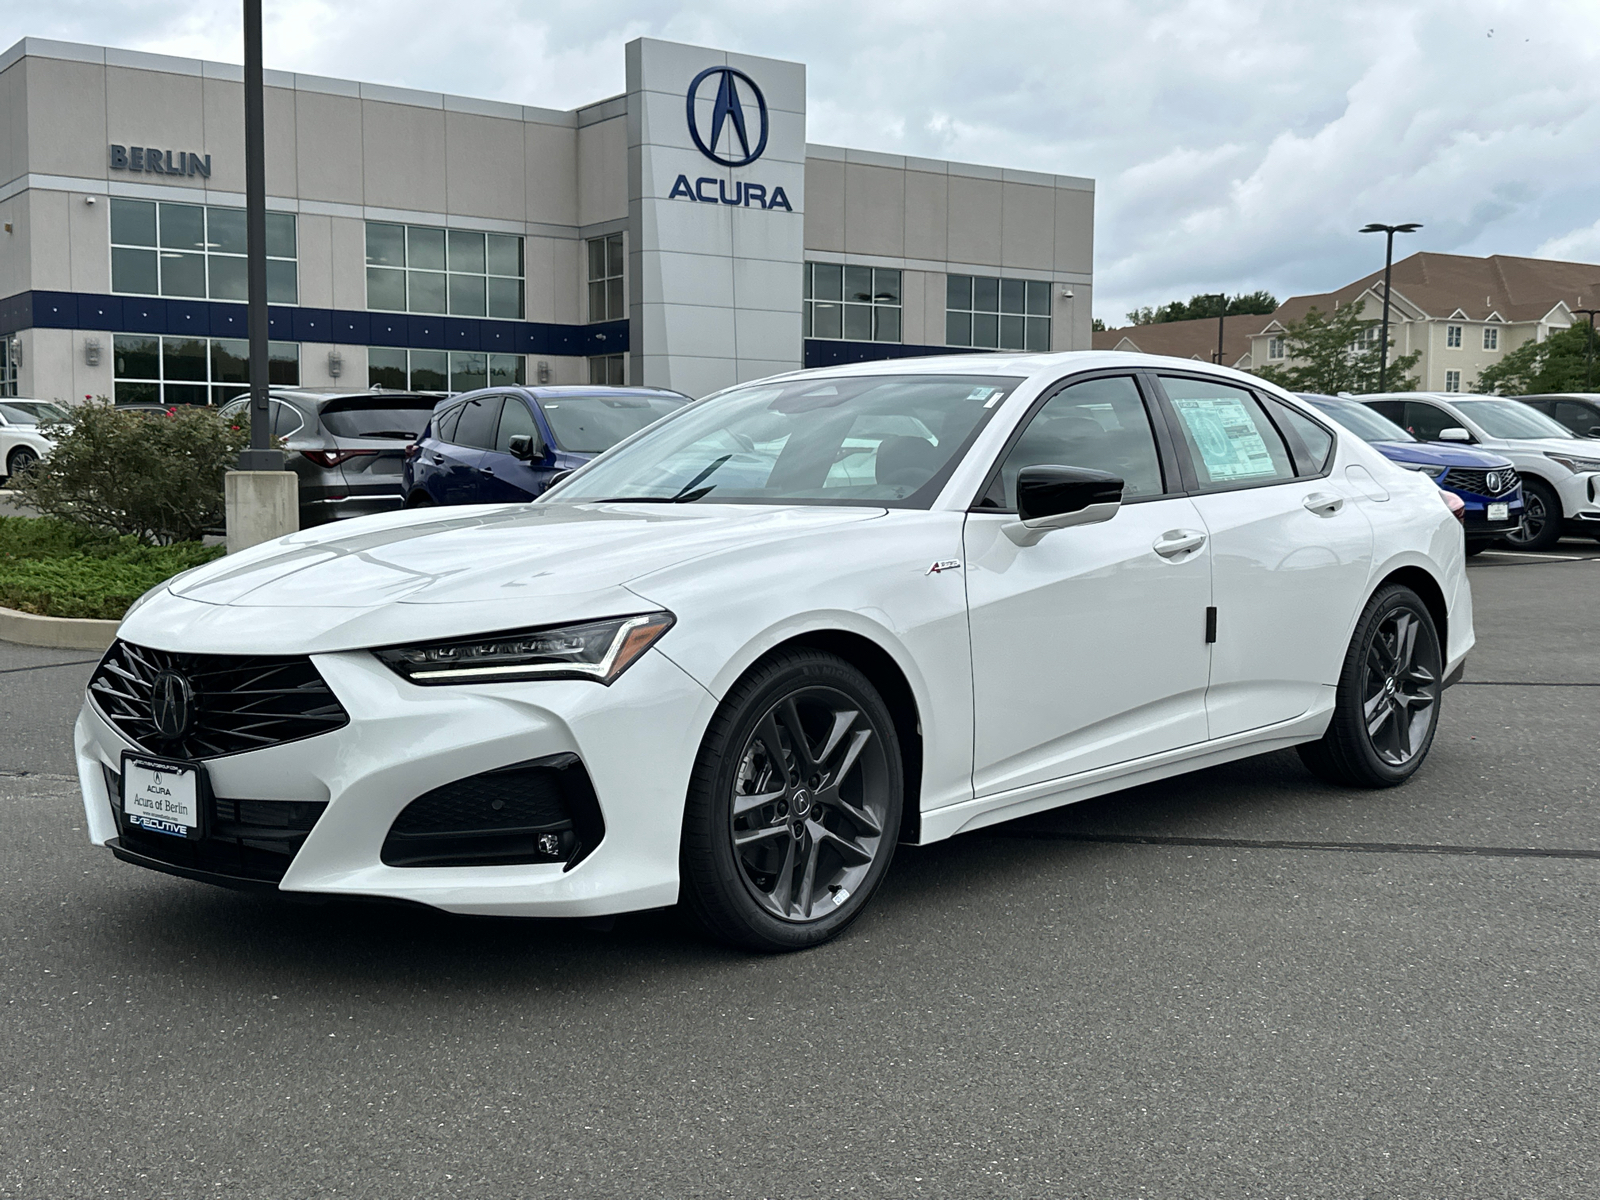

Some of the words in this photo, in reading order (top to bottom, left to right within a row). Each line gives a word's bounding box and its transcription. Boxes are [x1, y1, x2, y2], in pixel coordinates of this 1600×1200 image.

[110, 144, 211, 178] BERLIN
[668, 174, 793, 212] ACURA
[147, 784, 171, 796] ACURA
[134, 793, 153, 809] Acura
[155, 800, 163, 811] of
[165, 801, 188, 815] Berlin
[130, 815, 187, 835] EXECUTIVE
